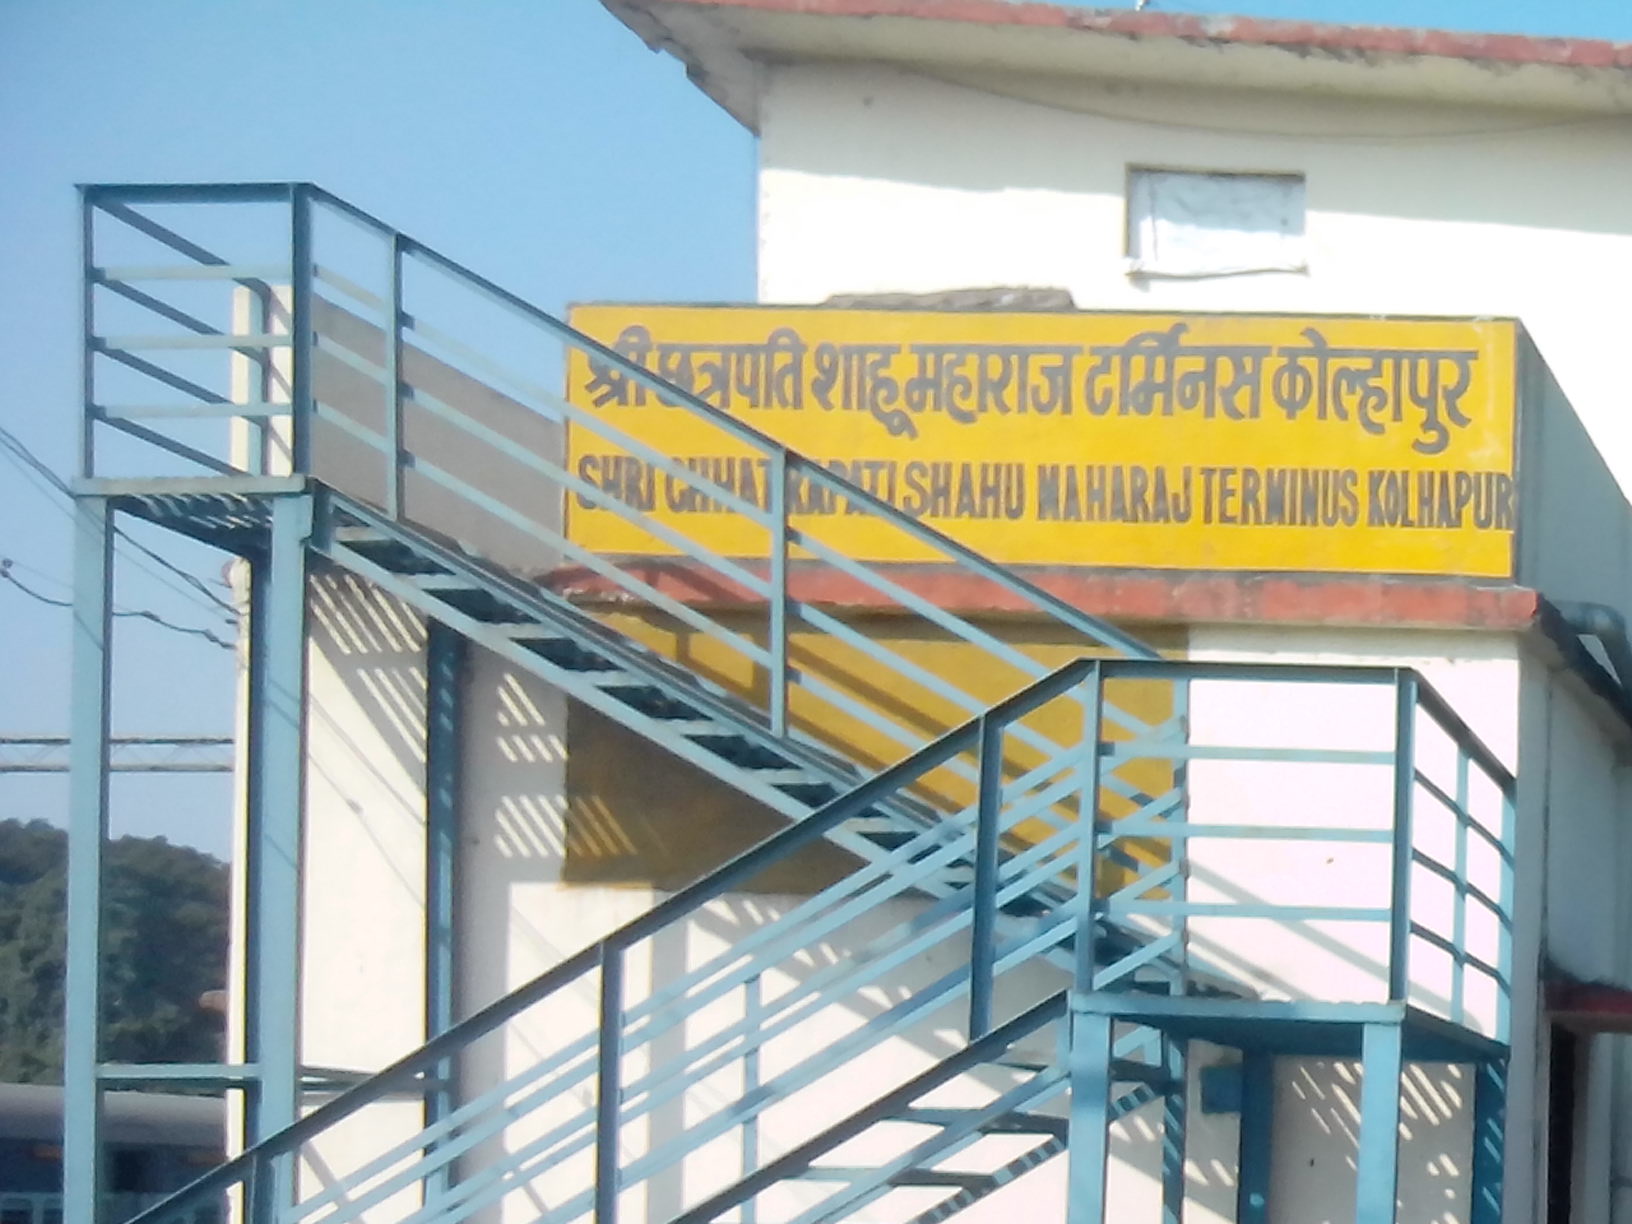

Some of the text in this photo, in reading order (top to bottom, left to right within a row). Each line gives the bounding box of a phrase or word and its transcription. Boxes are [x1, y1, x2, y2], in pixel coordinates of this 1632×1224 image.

[576, 453, 657, 514] SHRI
[902, 461, 1025, 521] SHAHU
[1036, 463, 1193, 525] MAHARAJ
[1199, 466, 1359, 529] TERMINUS
[1366, 470, 1515, 530] KOLHAPUR
